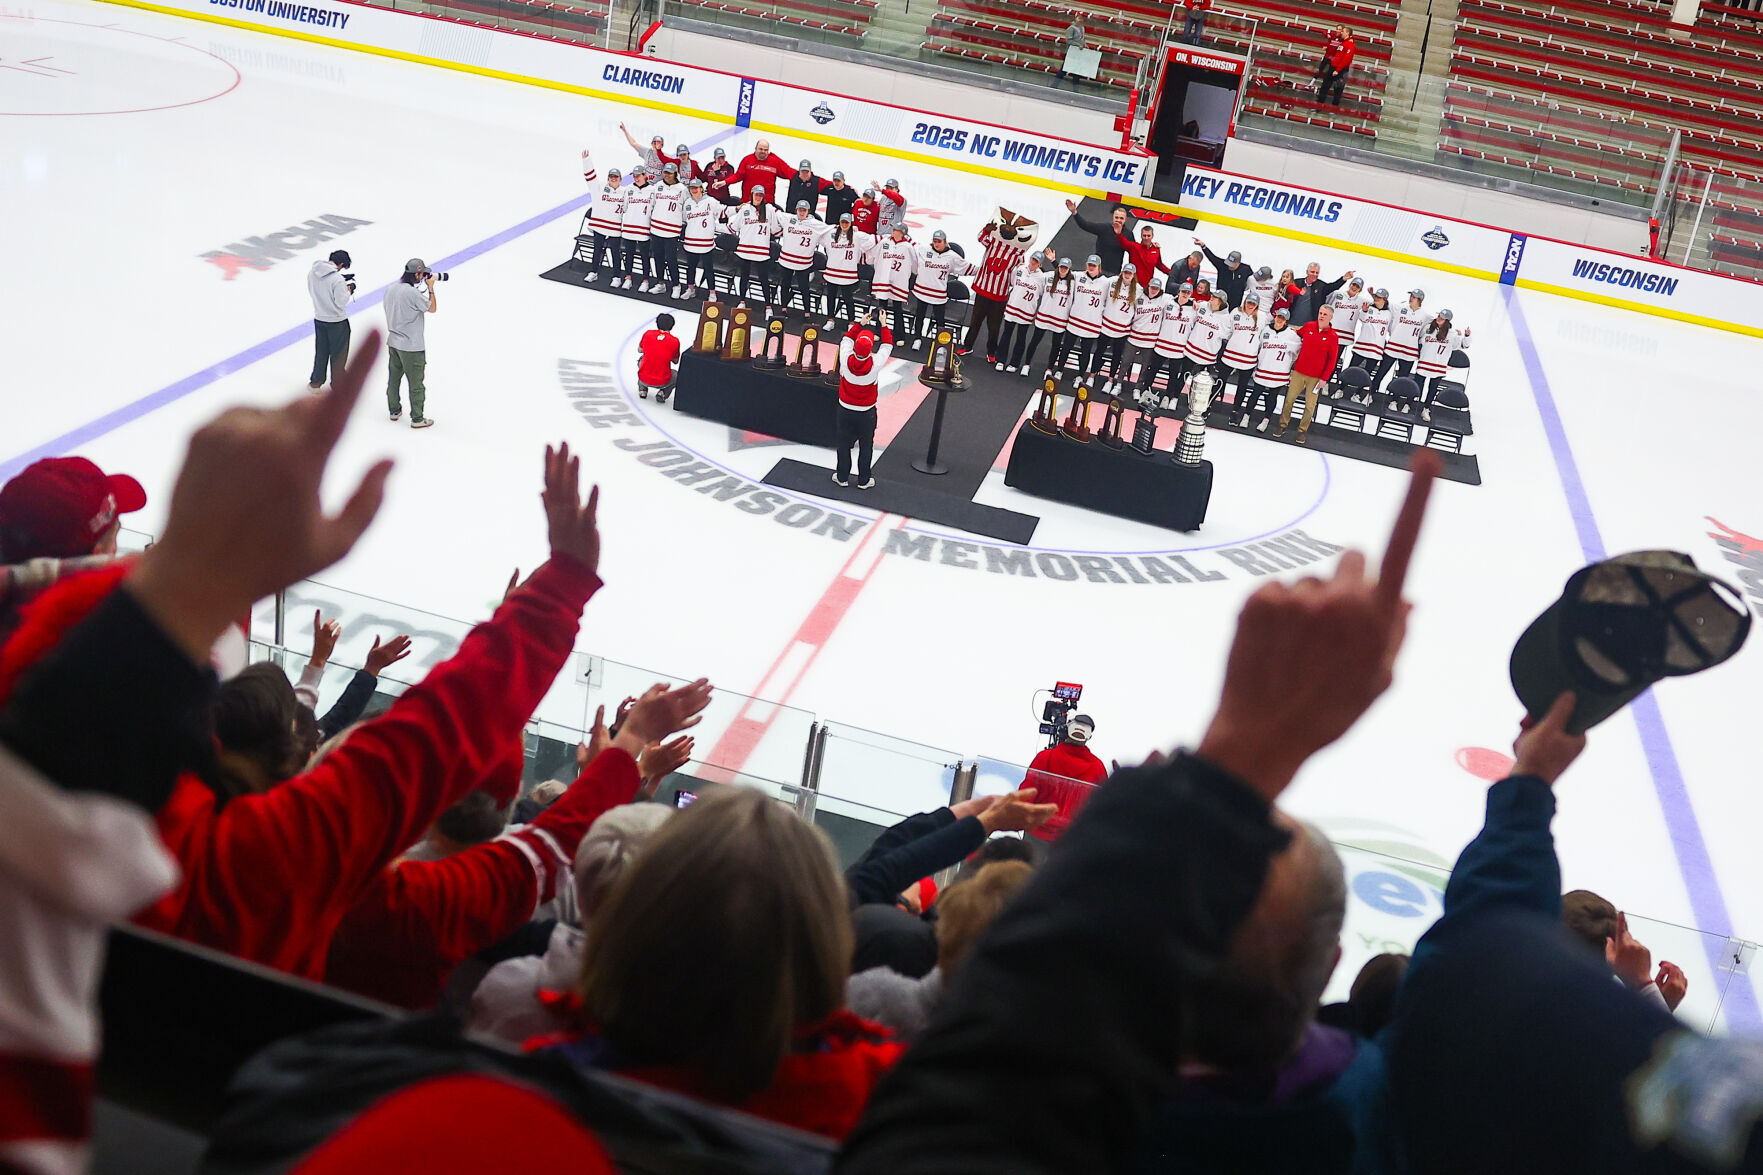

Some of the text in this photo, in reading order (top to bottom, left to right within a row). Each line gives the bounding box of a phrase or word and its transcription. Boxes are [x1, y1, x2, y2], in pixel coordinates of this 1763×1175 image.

[209, 0, 350, 29] STON UNIVERSITY
[1175, 52, 1238, 72] ON, WISCONSIN!
[602, 64, 685, 94] CLARKSON
[739, 81, 753, 116] NCAA
[911, 122, 968, 151] 2025
[969, 133, 1001, 158] NC
[1002, 139, 1102, 177] WOMEN'S
[1102, 158, 1139, 186] ICE
[668, 201, 677, 212] 10
[1224, 182, 1344, 223] REGIONALS
[643, 205, 648, 215] 4
[701, 218, 708, 228] 6
[758, 225, 767, 236] 24
[800, 236, 811, 247] 23
[844, 250, 854, 260] 18
[1504, 237, 1523, 272] NCAA
[891, 260, 902, 272] 32
[1572, 258, 1679, 296] WISCONSIN
[1022, 290, 1034, 302] 20
[1088, 296, 1100, 308] 30
[1119, 301, 1131, 314] 22
[1150, 313, 1160, 324] 19
[1349, 311, 1355, 321] 2
[1178, 324, 1186, 334] 11
[1379, 326, 1386, 336] 8
[1207, 331, 1214, 340] 9
[1248, 333, 1255, 343] 7
[1436, 344, 1446, 355] 17
[1276, 350, 1286, 361] 21
[557, 357, 1344, 584] LANCE JOHNSON MEMORIAL RINK
